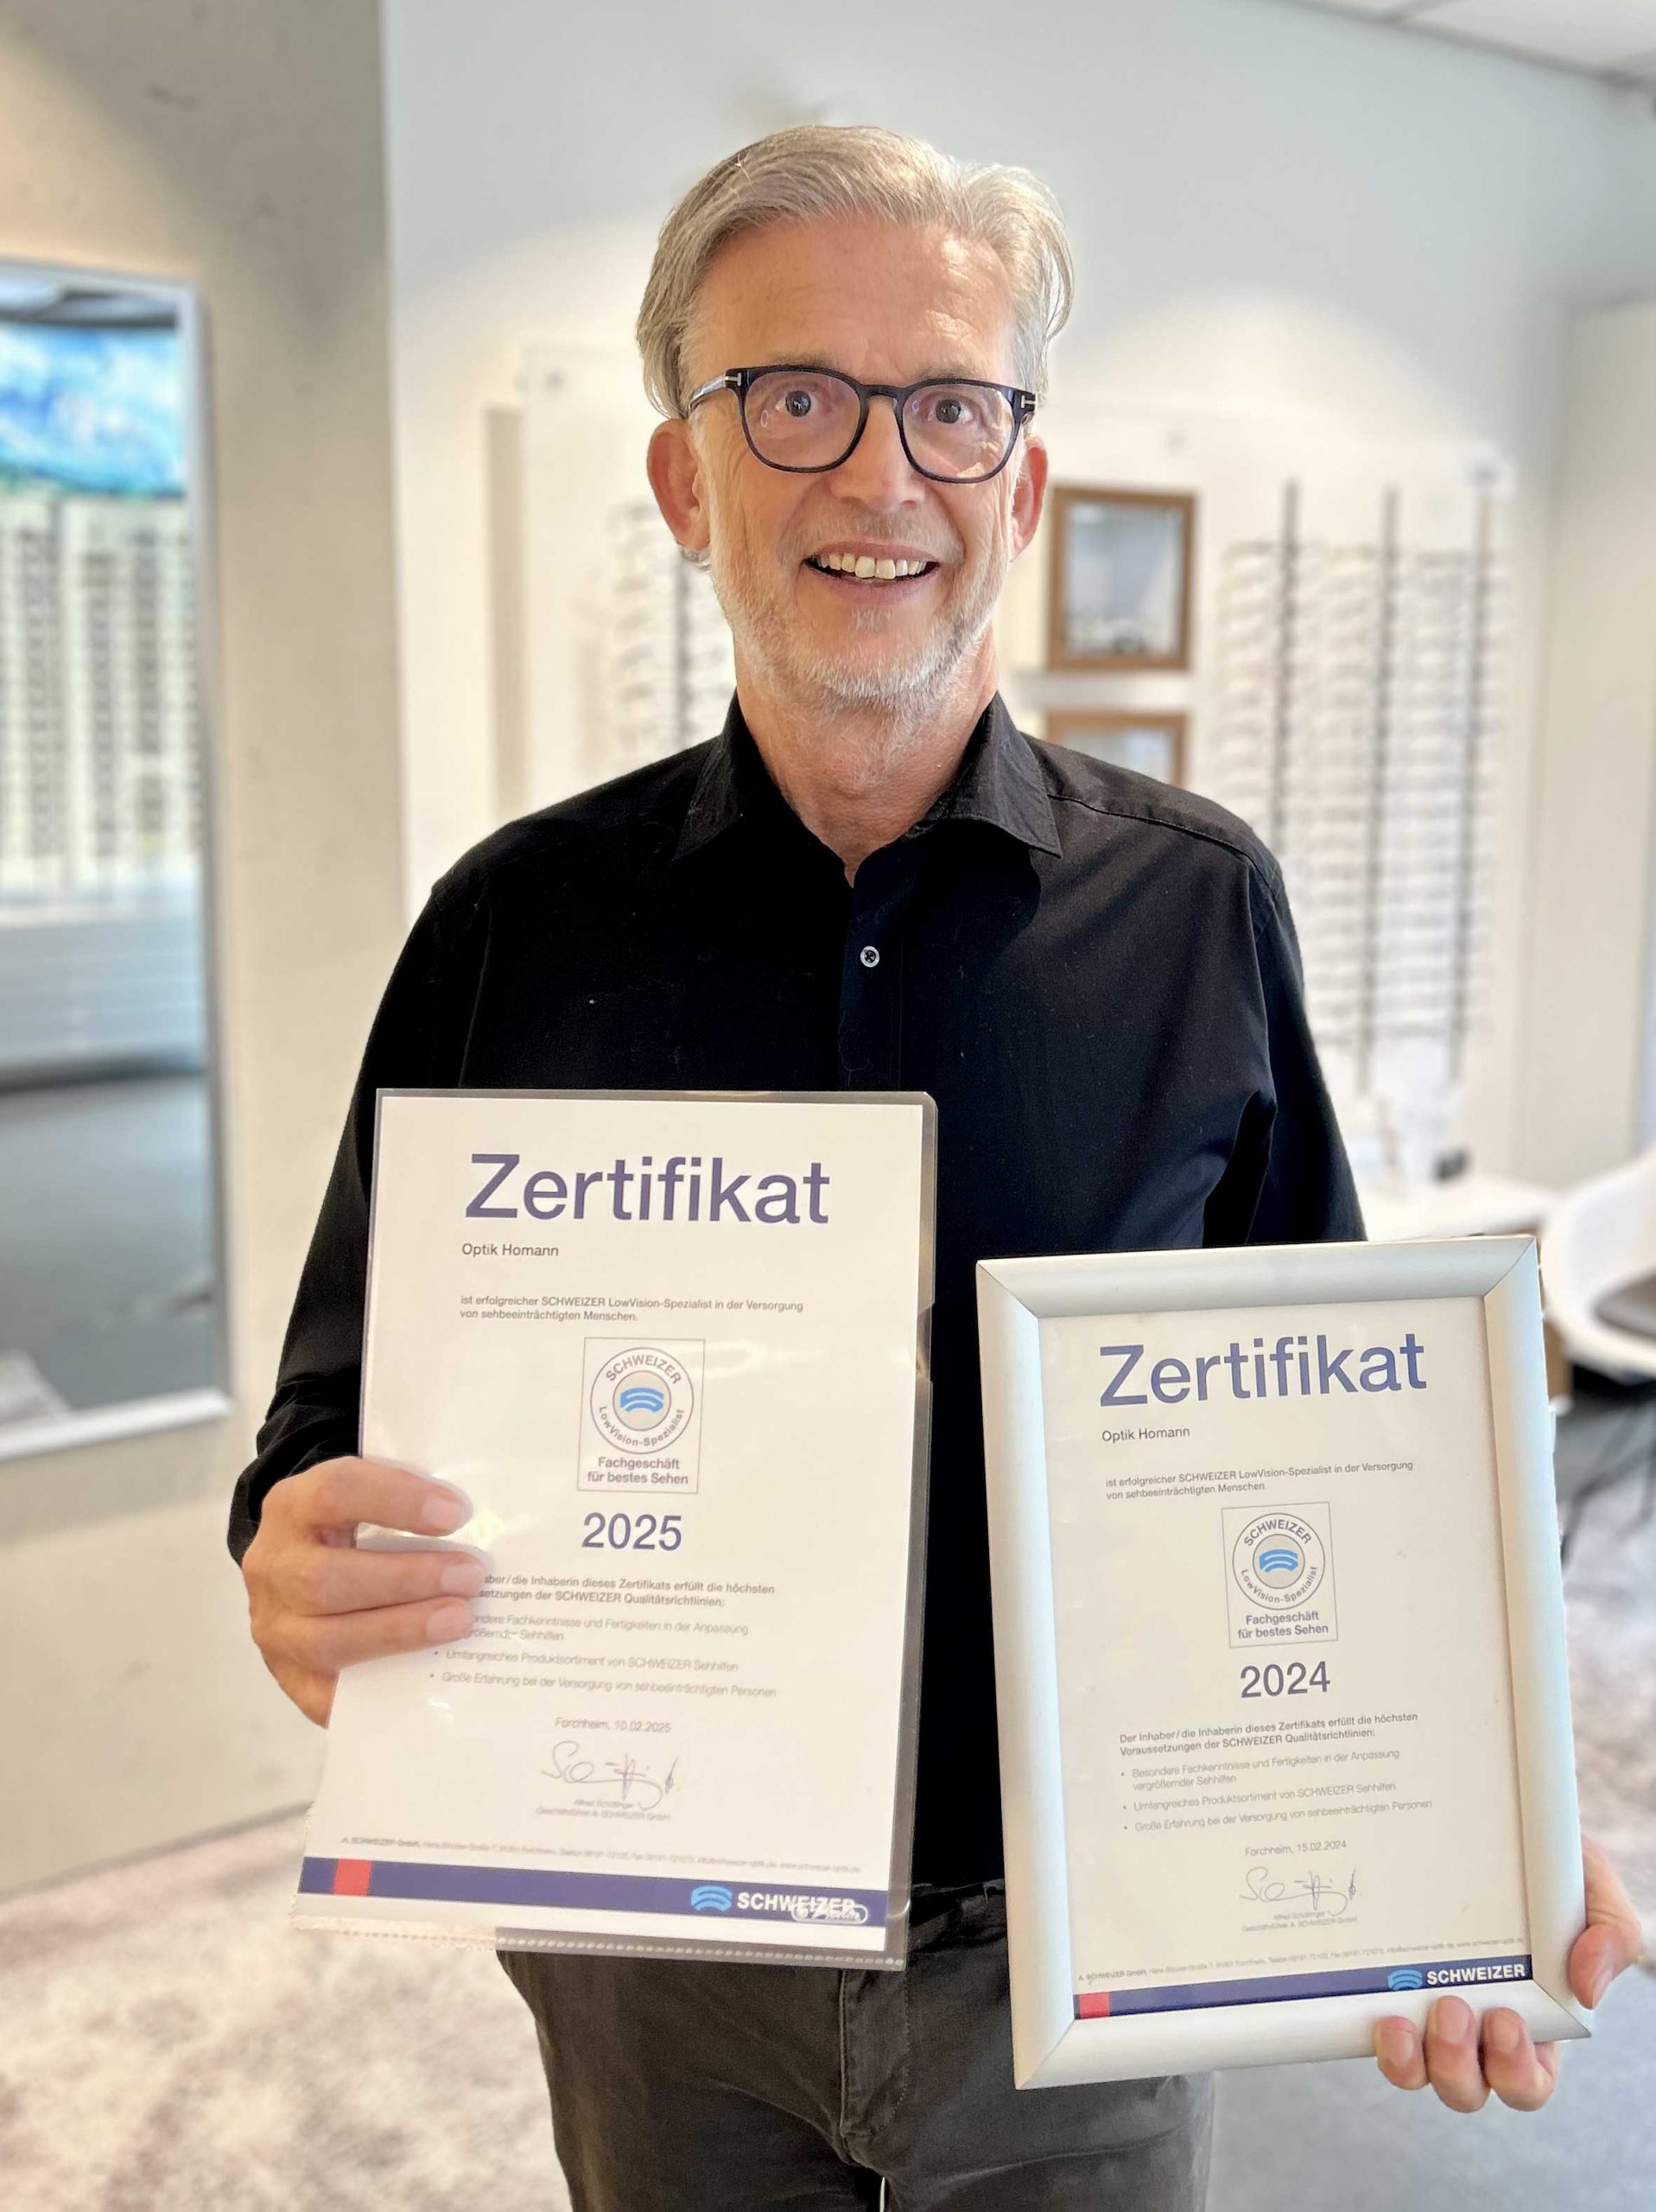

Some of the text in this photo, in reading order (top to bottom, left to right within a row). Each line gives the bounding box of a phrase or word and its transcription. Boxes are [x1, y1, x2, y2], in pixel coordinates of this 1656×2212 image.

[465, 1154, 830, 1224] Zertifikat
[462, 1243, 559, 1258] Optik Homann
[460, 1296, 803, 1313] ist erfolgreicher SCHWEIZER LowVision-Spezialist in der Versorgung
[481, 1310, 581, 1322] sehbeeinträchtigten
[584, 1311, 638, 1321] Menschen.
[606, 1354, 682, 1384] SCHWEIZER
[1100, 1333, 1427, 1407] Zertifikat
[599, 1406, 684, 1447] LowVision-Spezialist
[1101, 1426, 1190, 1444] Optik Homann
[598, 1457, 680, 1471] Fachgeschäft
[587, 1471, 688, 1484] für bestes Sehen
[1106, 1478, 1117, 1487] ist
[1119, 1475, 1176, 1488] erfolgreicher
[1178, 1471, 1236, 1483] SCHWEIZER
[1239, 1465, 1331, 1479] LowVision-Spezialist
[1345, 1464, 1360, 1473] der
[1361, 1462, 1413, 1472] Versorgung
[1126, 1485, 1215, 1499] sehbeeinträchtigten
[581, 1512, 682, 1551] 2025
[1244, 1519, 1312, 1547] SCHWEIZER
[531, 1575, 579, 1586] Inhaberin
[582, 1578, 616, 1588] dieses
[619, 1579, 671, 1591] Zertifikats
[674, 1581, 704, 1591] erfüllt
[707, 1582, 722, 1592] die
[726, 1583, 775, 1594] höchsten
[1241, 1566, 1317, 1604] LowVision-Spezialist
[535, 1590, 552, 1600] der
[555, 1591, 621, 1603] SCHWEIZER
[584, 1618, 603, 1628] und
[663, 1622, 672, 1631] in
[675, 1622, 692, 1631] der
[1246, 1611, 1319, 1625] Fachgeschäft
[1237, 1624, 1329, 1639] für bestes Sehen
[628, 1657, 691, 1669] SCHWEIZER
[1240, 1661, 1330, 1699] 2024
[1120, 1733, 1136, 1744] Der
[1198, 1725, 1242, 1737] Inhaberin
[1245, 1723, 1276, 1733] dieses
[1278, 1719, 1326, 1732] Zertifikats
[1328, 1717, 1355, 1727] erfüllt
[1357, 1715, 1372, 1726] die
[1374, 1713, 1418, 1724] höchsten
[1120, 1742, 1202, 1756] Voraussetzungen
[1204, 1739, 1221, 1750] der
[1222, 1735, 1283, 1747] SCHWEIZER
[1252, 1758, 1269, 1769] und
[1324, 1754, 1332, 1763] in
[1334, 1752, 1348, 1762] der
[1351, 1750, 1400, 1761] Anpassung
[1279, 1790, 1296, 1799] von
[1298, 1785, 1354, 1798] SCHWEIZER
[1222, 1815, 1236, 1824] der
[1298, 1840, 1347, 1853] 15.02.2024
[737, 1891, 856, 1915] SCHWEIZER
[1427, 1964, 1526, 1985] SCHWEIZER
